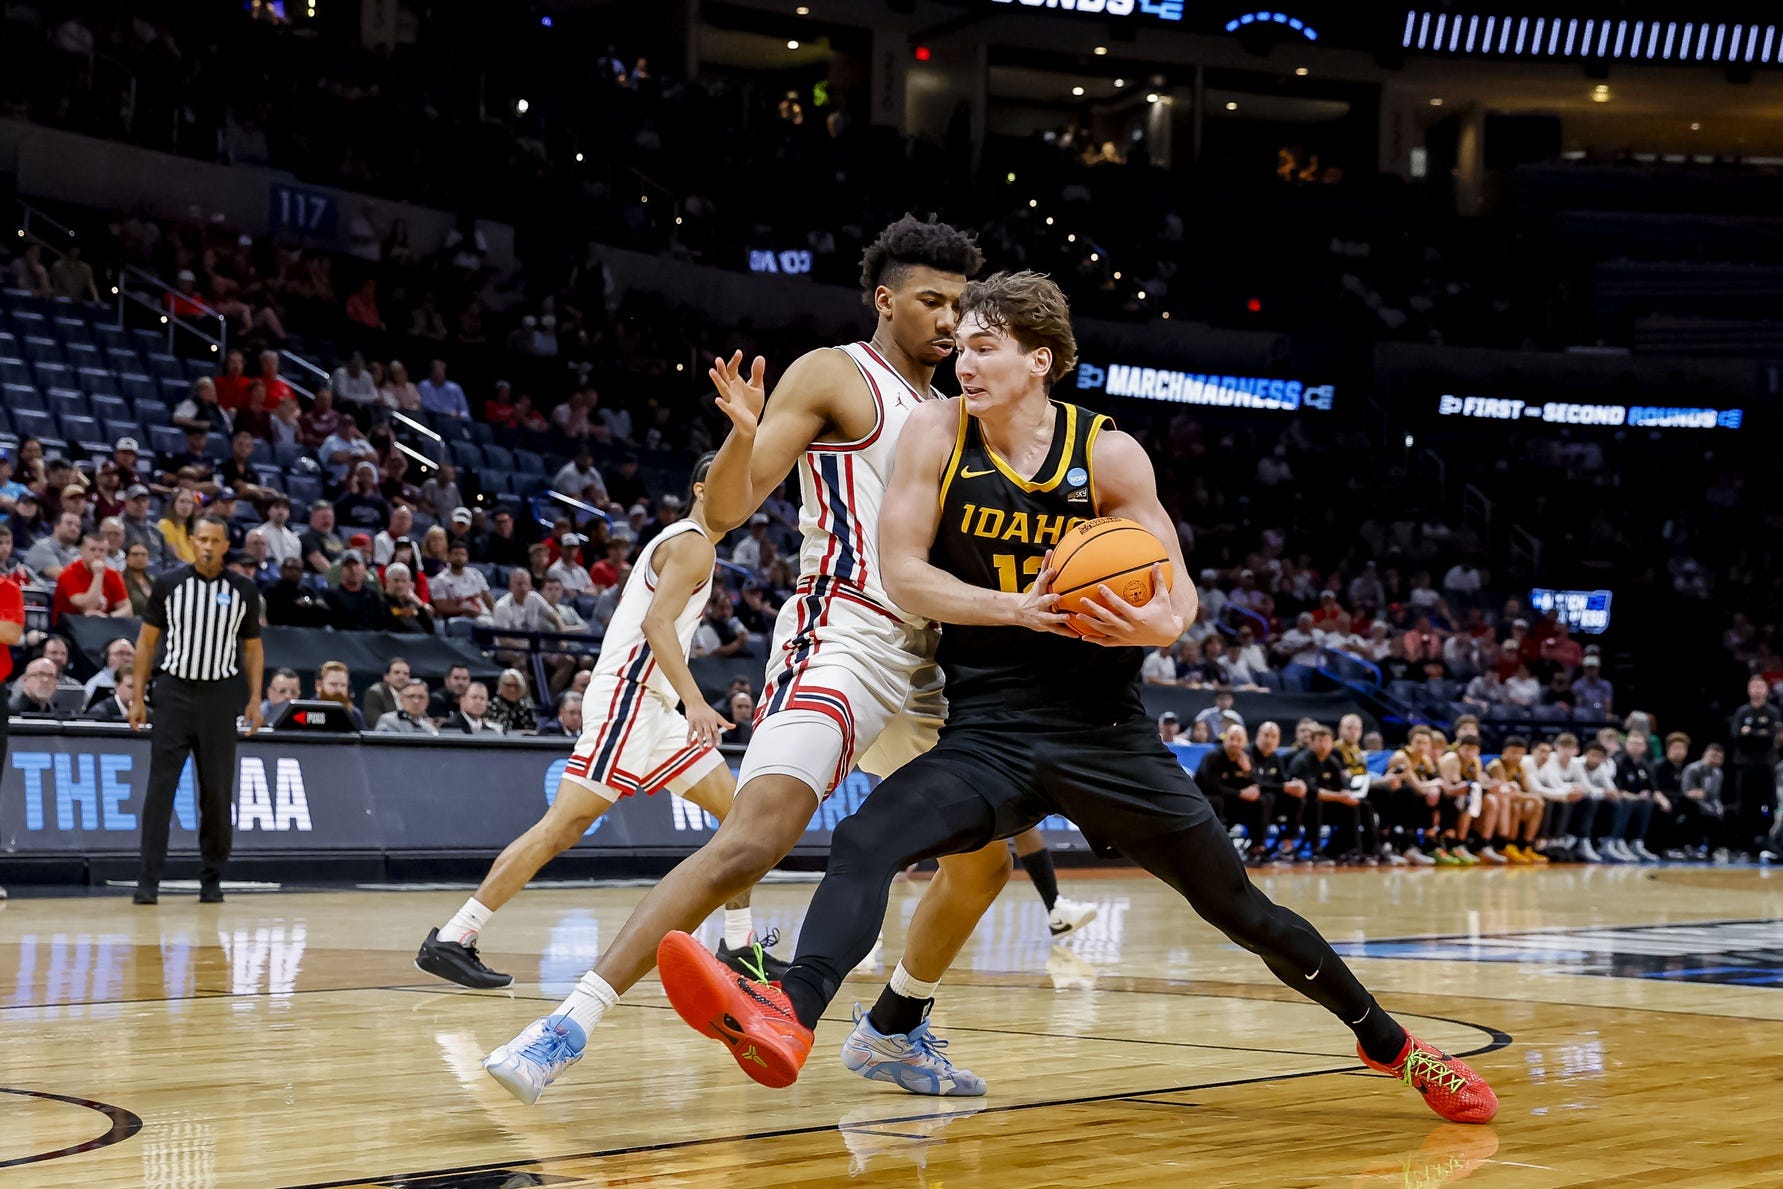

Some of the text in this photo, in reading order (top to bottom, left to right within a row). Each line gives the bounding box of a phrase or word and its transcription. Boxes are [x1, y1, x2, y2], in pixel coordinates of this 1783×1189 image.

[279, 190, 327, 229] 117
[1463, 397, 1525, 419] FIRST
[1542, 402, 1626, 425] SECOND
[1627, 406, 1718, 428] ROUNDS
[12, 752, 313, 832] THE AA
